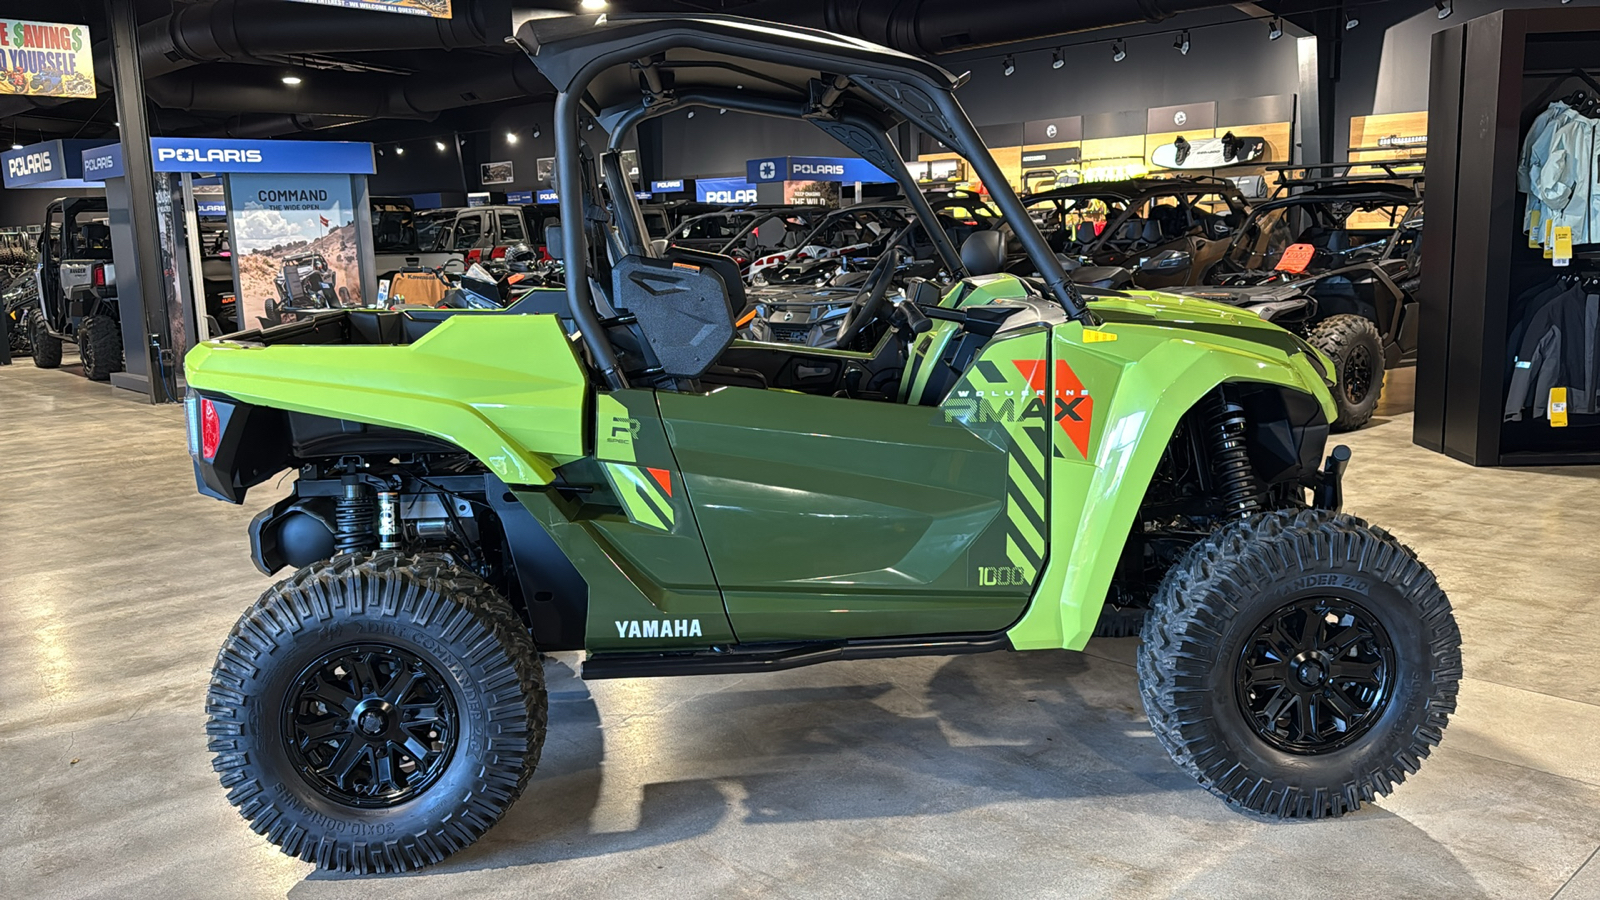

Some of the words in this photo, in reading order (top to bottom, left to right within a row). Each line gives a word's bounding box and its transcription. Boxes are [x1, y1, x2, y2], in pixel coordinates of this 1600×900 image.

[360, 3, 387, 12] WELCOME
[398, 7, 428, 15] QUESTIONS
[8, 48, 77, 76] YOURSELF
[157, 148, 263, 163] POLARIS
[8, 151, 52, 178] POLARIS
[84, 155, 114, 172] POLARIS
[792, 164, 844, 175] POLARIS
[656, 181, 681, 189] POLARIS
[258, 189, 328, 203] COMMAND
[706, 189, 757, 204] POLAR
[944, 397, 1086, 423] RMAX
[606, 437, 630, 445] SPEC
[978, 566, 1025, 586] 1000
[615, 618, 703, 638] YAMAHA
